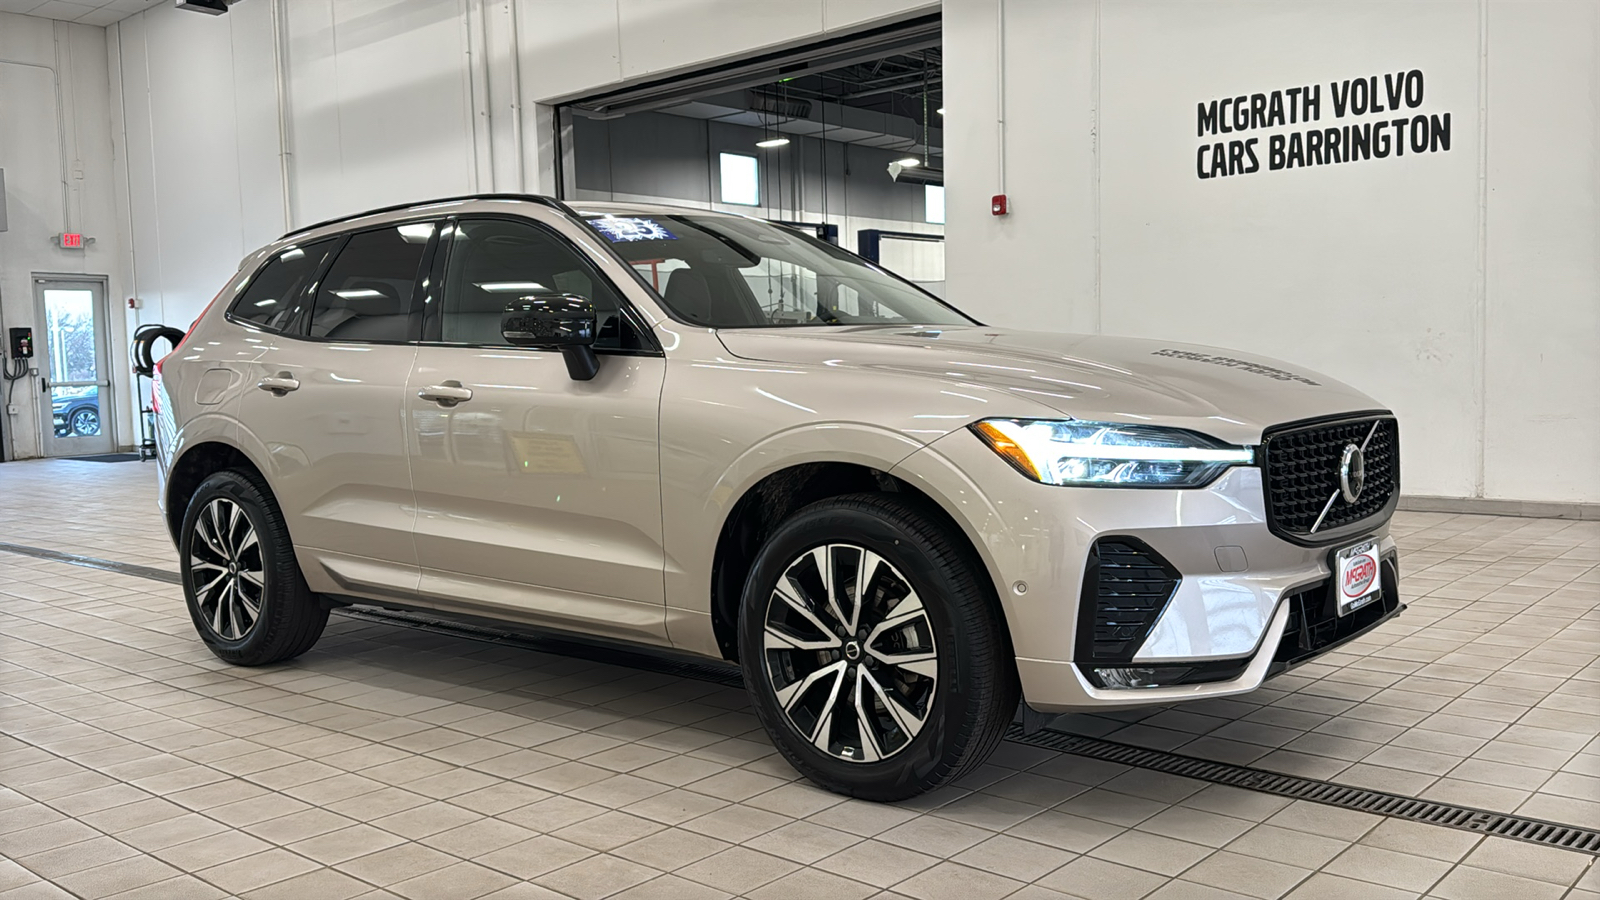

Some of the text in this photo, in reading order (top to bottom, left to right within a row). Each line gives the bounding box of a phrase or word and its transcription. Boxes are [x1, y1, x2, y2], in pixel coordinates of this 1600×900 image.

[1197, 69, 1424, 137] MCGRATH VOLVO
[1197, 112, 1451, 180] CARS BARRINGTON
